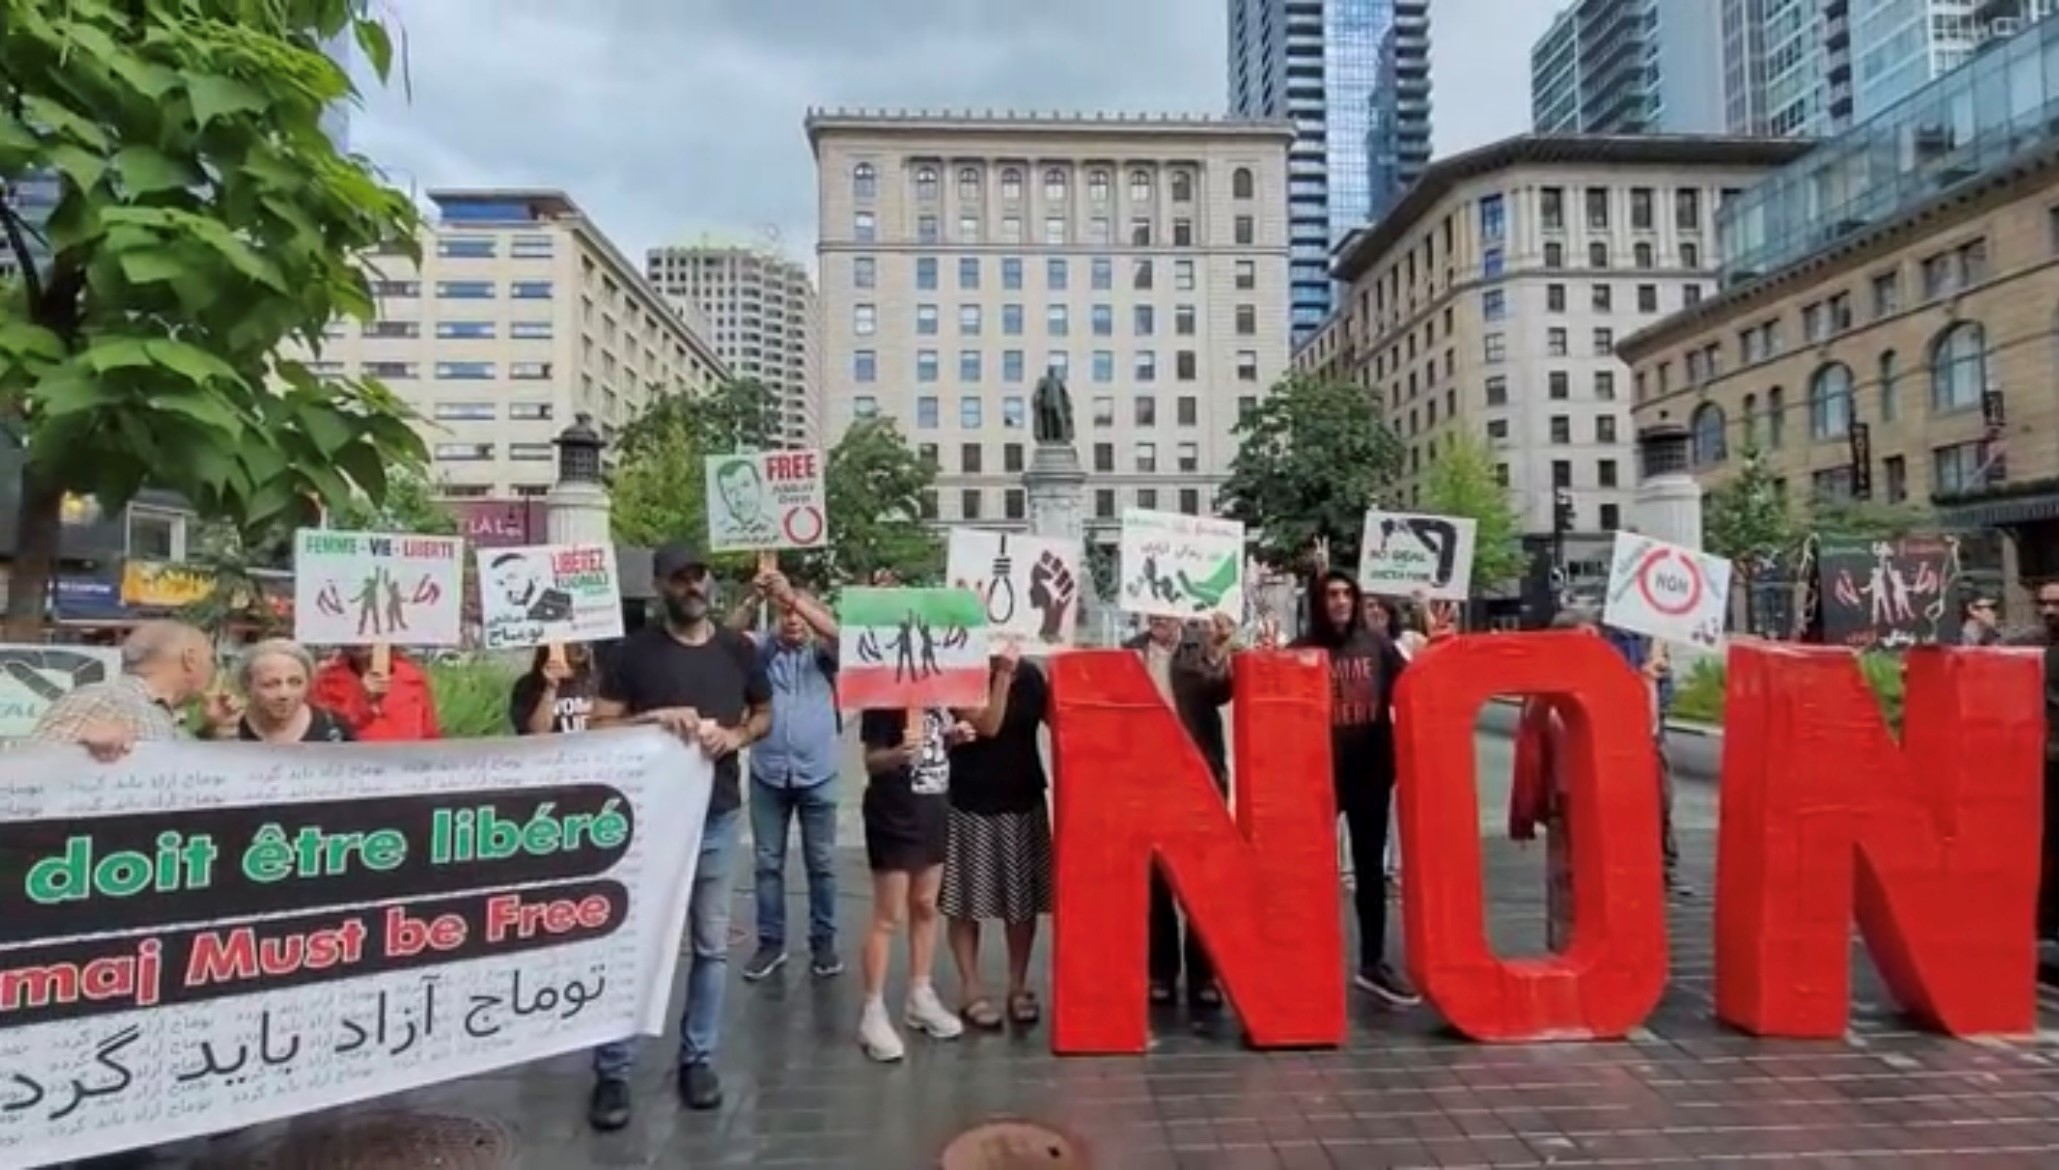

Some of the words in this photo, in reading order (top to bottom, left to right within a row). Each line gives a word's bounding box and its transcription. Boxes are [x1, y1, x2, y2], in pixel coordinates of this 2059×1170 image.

[766, 453, 816, 481] FREE
[306, 535, 356, 554] FEMME
[369, 537, 392, 556] VIE
[1655, 573, 1690, 595] NON
[25, 831, 218, 904] doit
[242, 823, 409, 882] être
[431, 799, 629, 864] libéré
[1052, 631, 2045, 1055] NON
[184, 919, 367, 986] Must
[385, 906, 468, 957] be
[486, 895, 611, 943] Free
[334, 975, 441, 1056] آزاد
[464, 963, 606, 1037] توماج
[177, 1010, 299, 1086] باید
